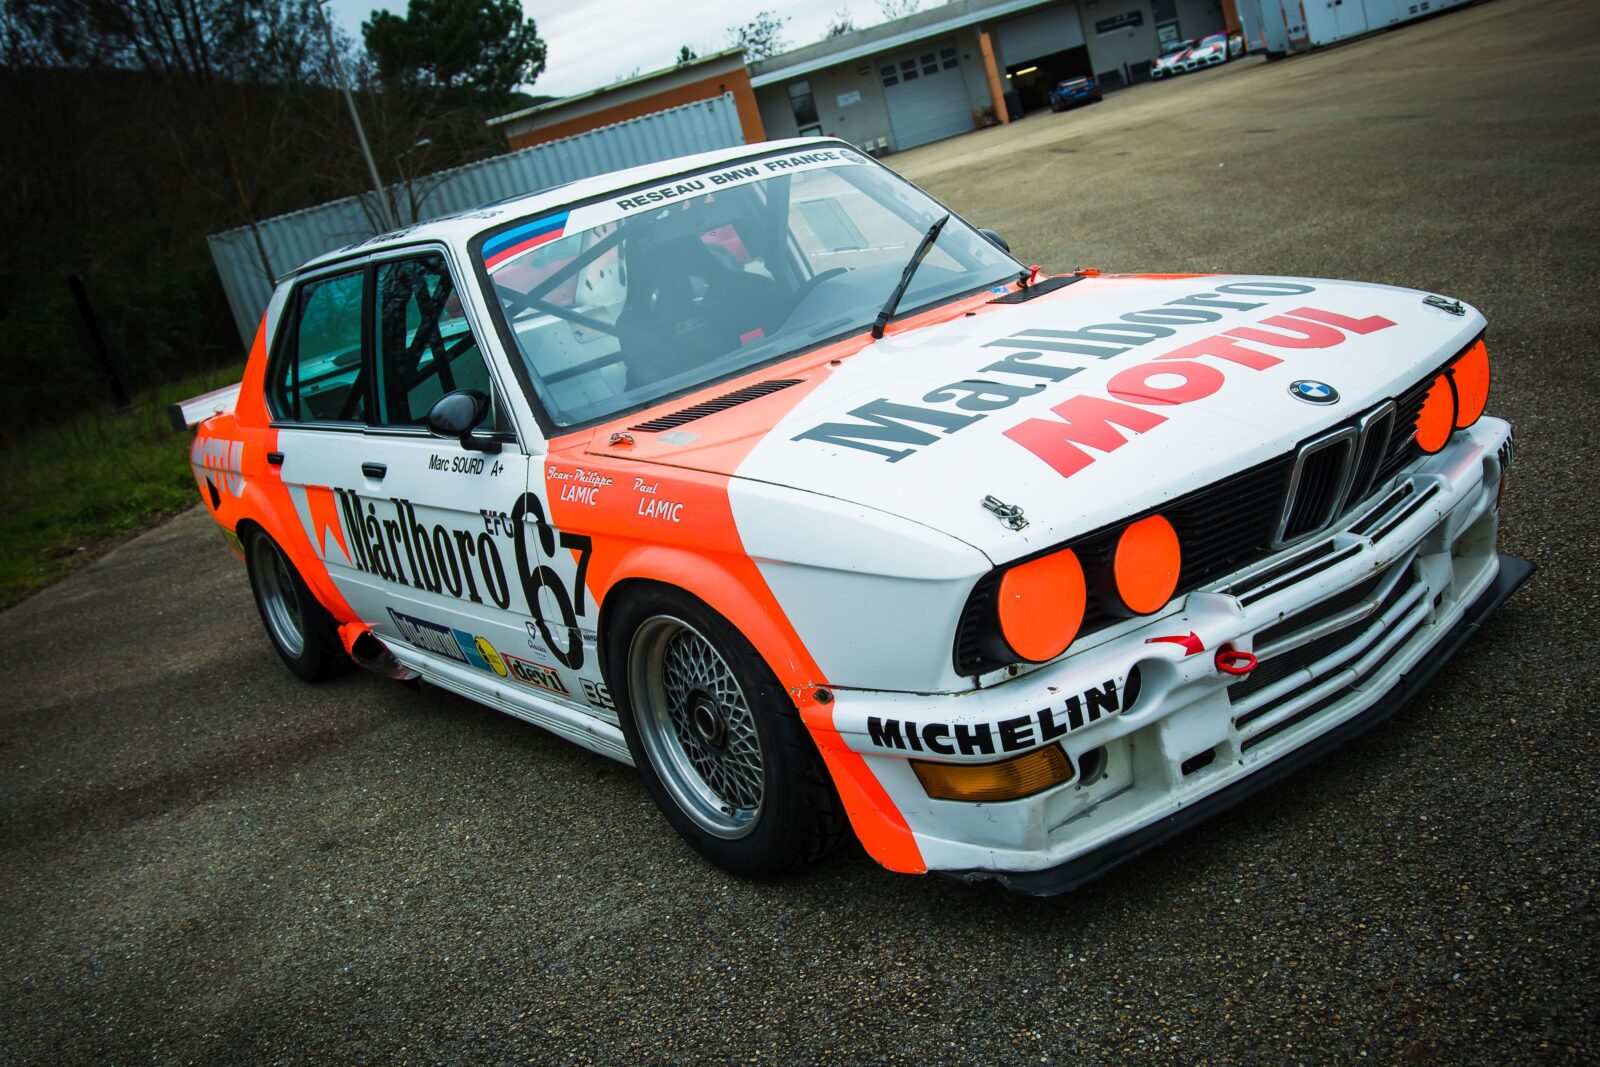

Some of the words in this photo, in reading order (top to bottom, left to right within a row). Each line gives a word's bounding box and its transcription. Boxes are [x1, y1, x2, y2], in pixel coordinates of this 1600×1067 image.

[616, 180, 705, 211] RESEAU
[708, 166, 760, 186] BMW
[764, 151, 841, 172] FRANCE
[789, 281, 1317, 464] Marlboro
[1003, 306, 1399, 479] MOTUL
[429, 454, 450, 472] Marc
[451, 456, 485, 475] SOURD
[490, 460, 504, 476] A+
[547, 465, 614, 487] Jean-Philippe
[560, 484, 599, 506] LAMIC
[633, 477, 659, 494] Paul
[637, 497, 684, 523] LAMIC
[334, 487, 510, 610] Marlboro
[512, 659, 569, 695] devil
[867, 678, 1121, 756] MICHELIN
